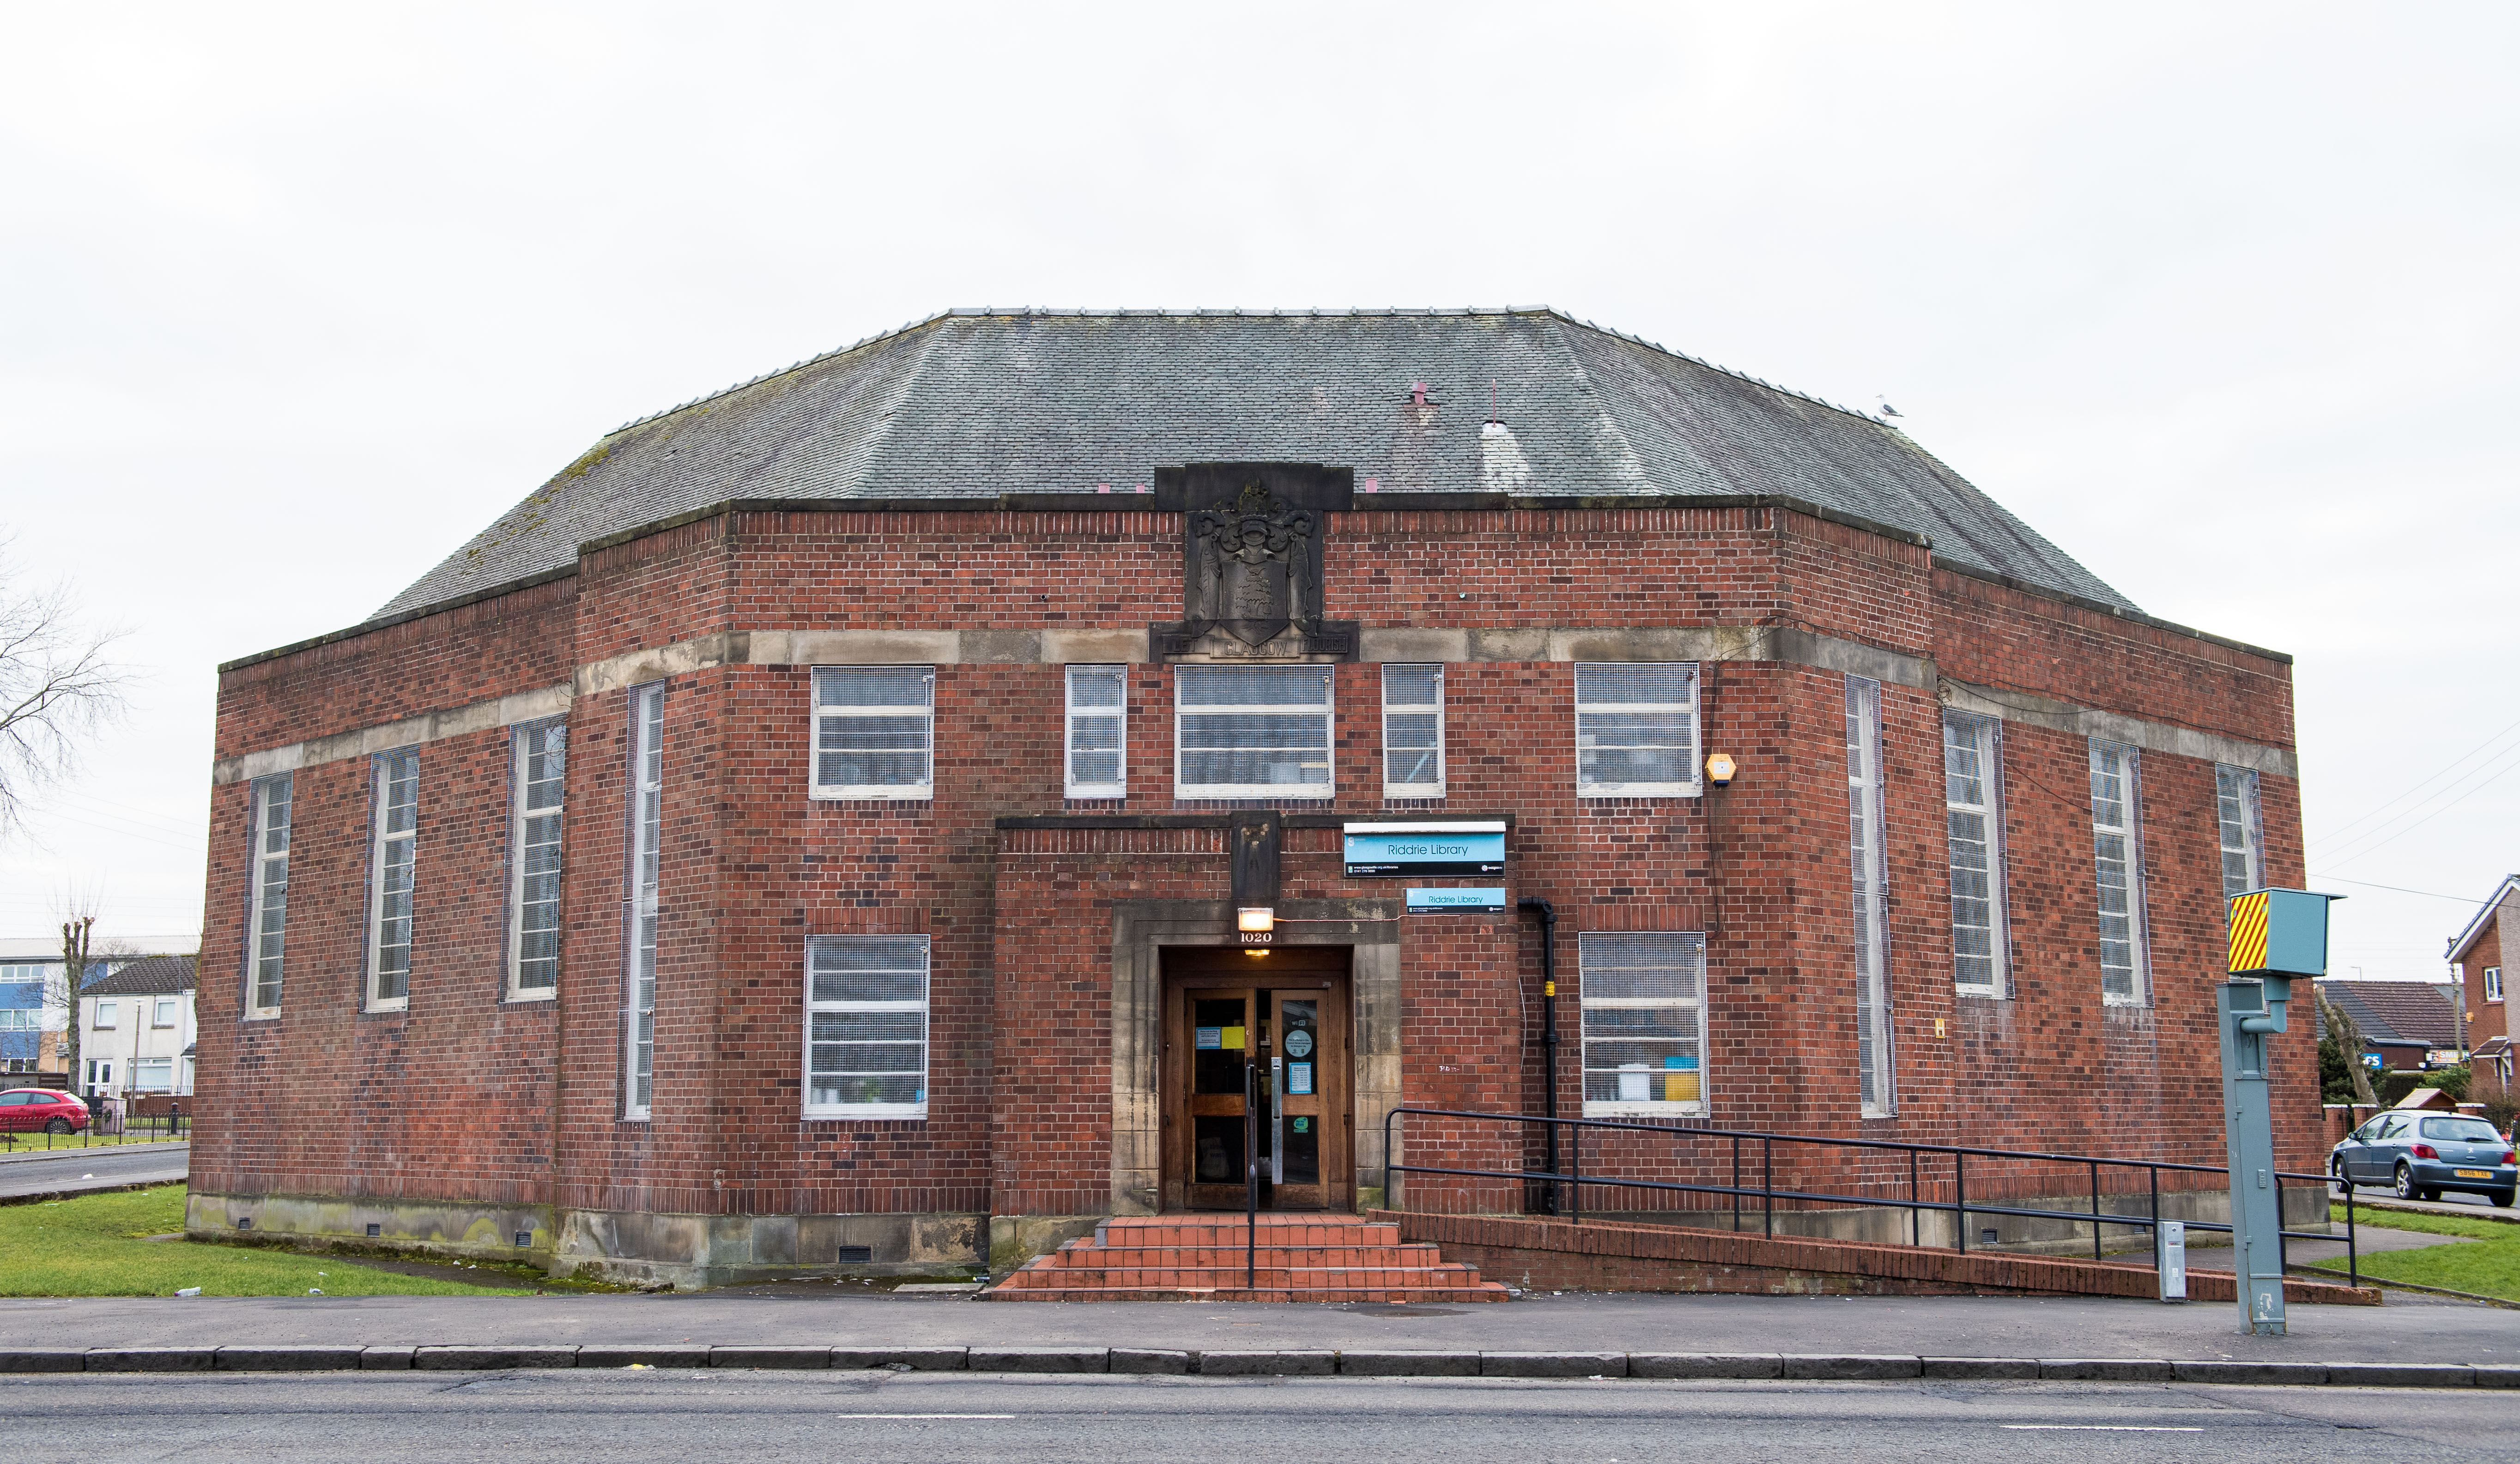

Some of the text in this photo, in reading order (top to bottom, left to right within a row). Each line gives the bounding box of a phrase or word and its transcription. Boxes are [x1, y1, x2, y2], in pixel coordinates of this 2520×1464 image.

[1173, 639, 1196, 652] LET
[1302, 639, 1346, 652] FLOURISH
[1388, 844, 1468, 856] Riddrie Library
[1241, 933, 1272, 942] 1020
